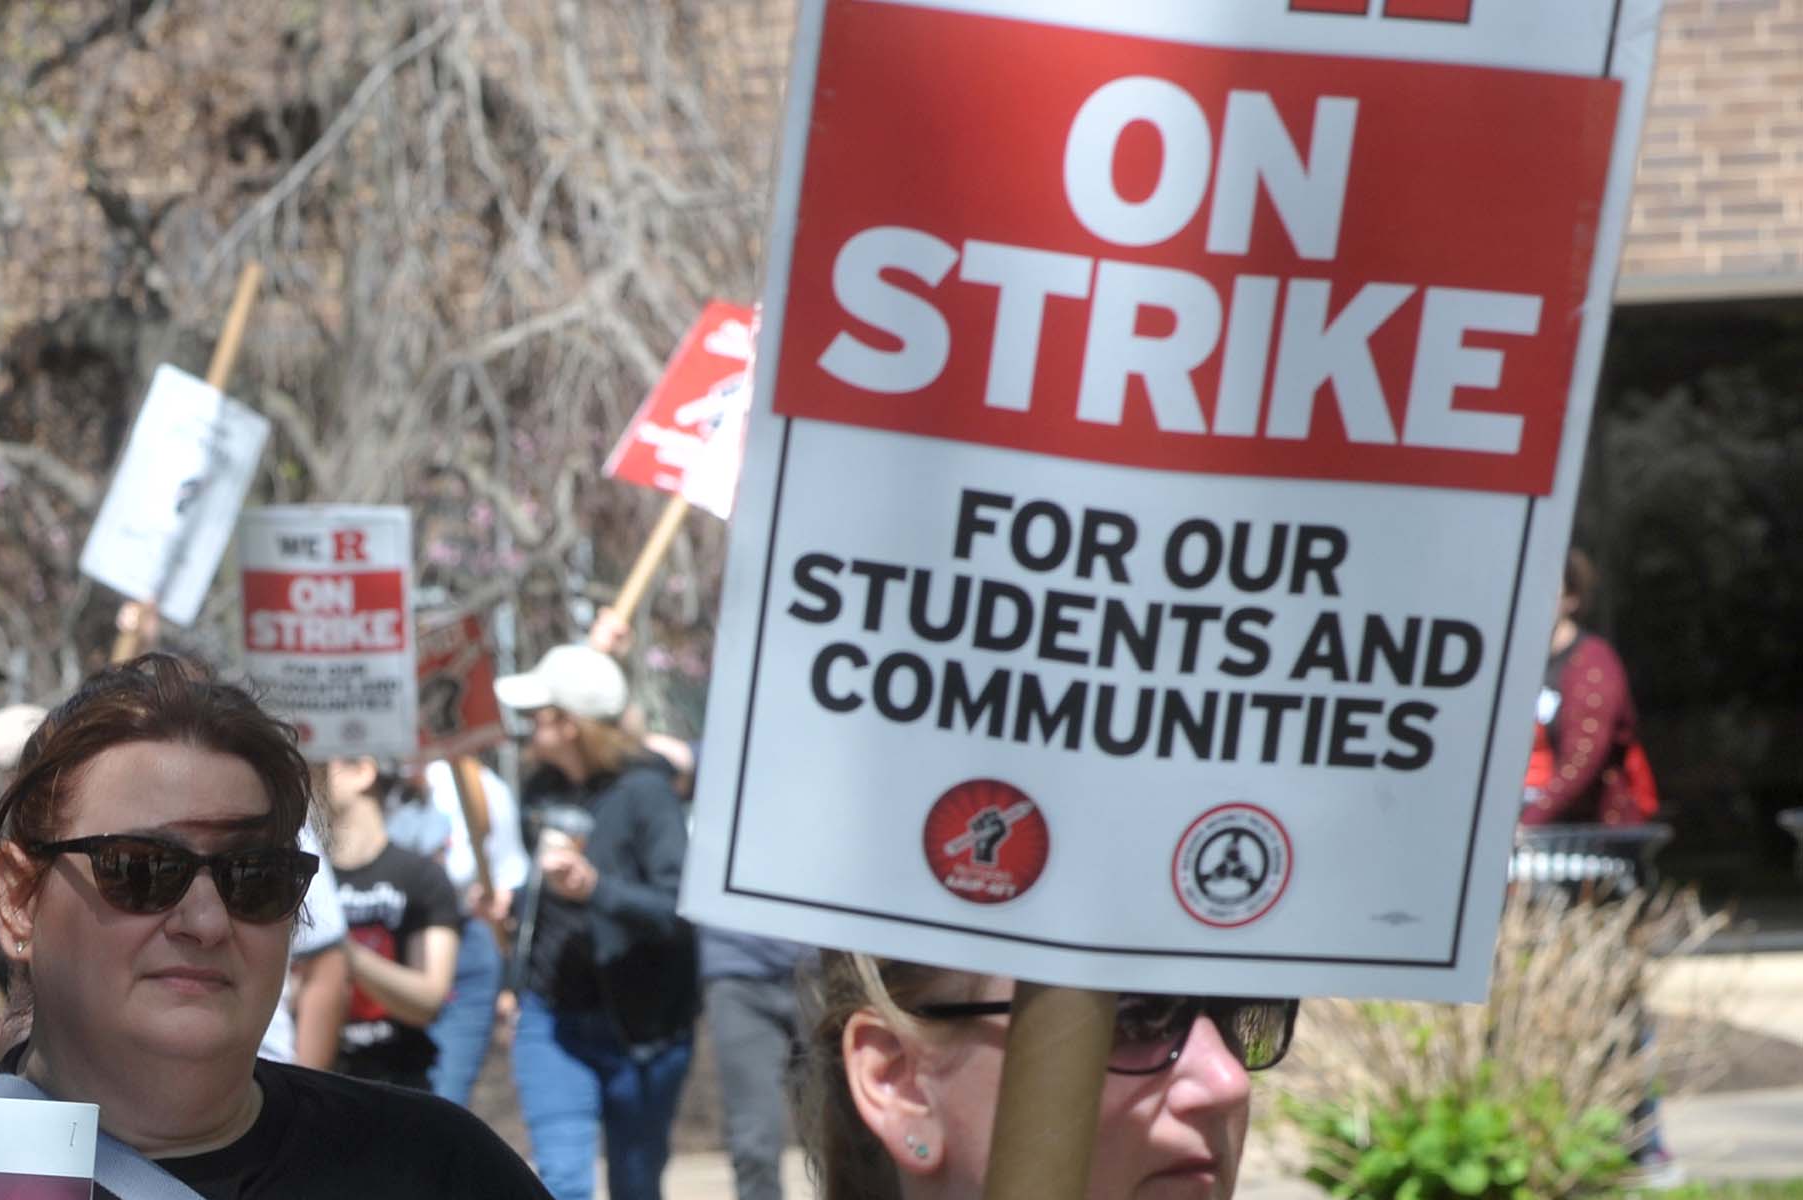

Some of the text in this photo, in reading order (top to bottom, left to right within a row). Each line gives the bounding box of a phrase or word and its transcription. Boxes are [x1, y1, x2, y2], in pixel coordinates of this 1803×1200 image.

[1063, 75, 1360, 261] ON
[816, 225, 1544, 455] STRIKE
[287, 575, 356, 612] ON
[332, 528, 367, 562] R
[953, 488, 1349, 597] FOR OUR
[249, 608, 401, 651] STRIKE
[787, 552, 1485, 689] STUDENTS AND
[810, 642, 1439, 771] COMMUNITIES
